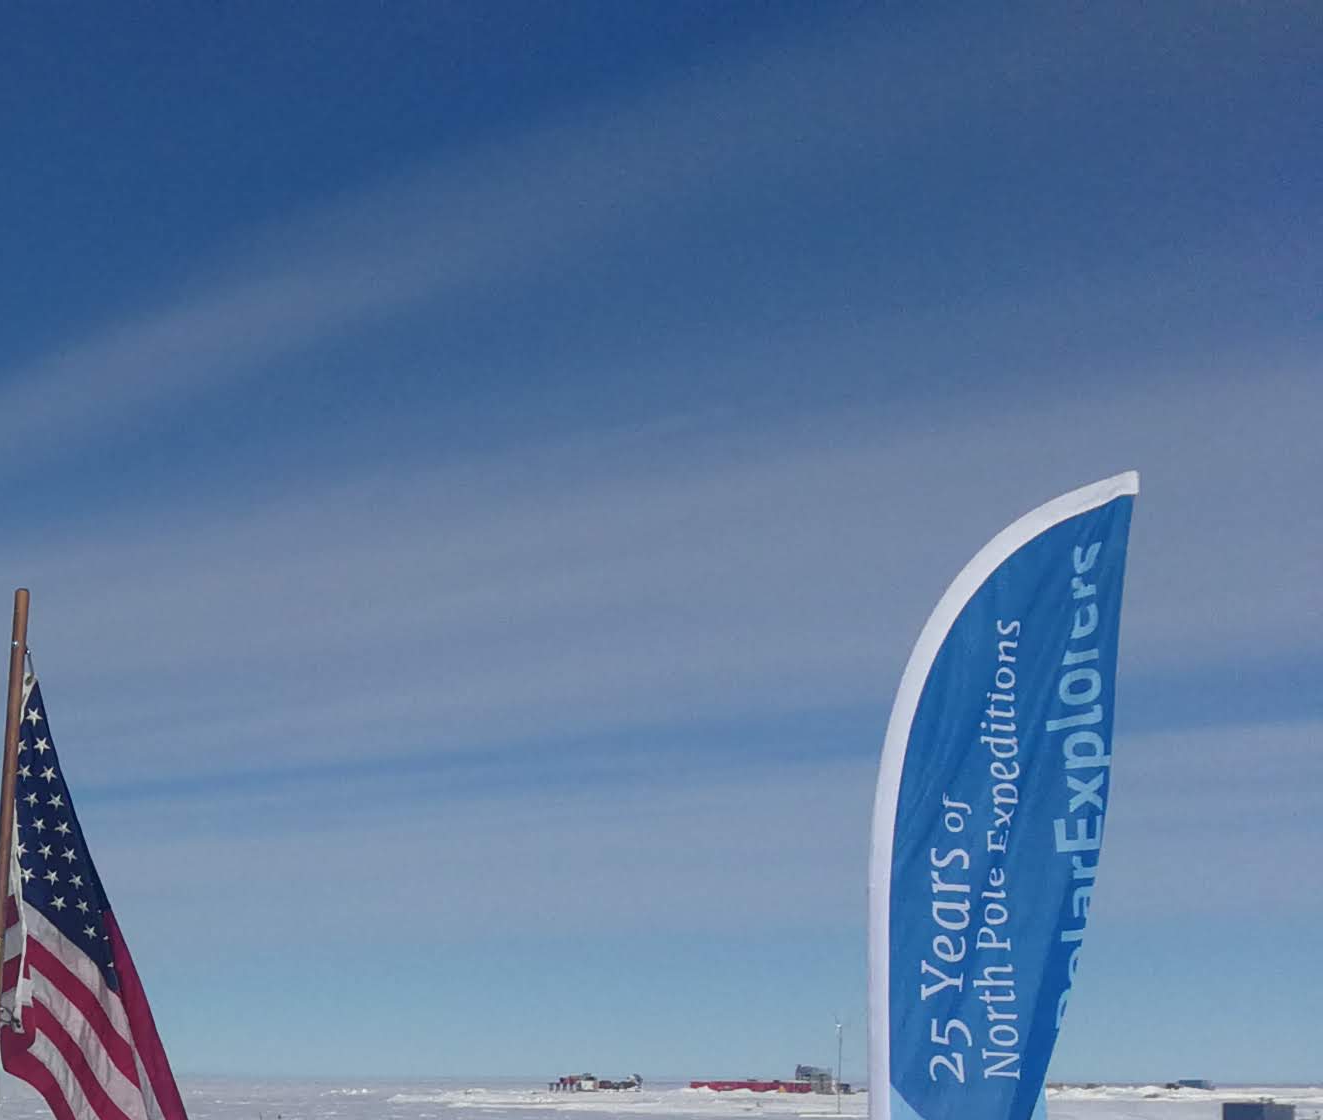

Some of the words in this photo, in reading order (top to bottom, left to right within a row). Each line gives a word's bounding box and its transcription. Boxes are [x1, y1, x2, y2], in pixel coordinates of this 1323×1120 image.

[980, 619, 1021, 854] Expeditions
[942, 792, 973, 833] of
[921, 848, 971, 1001] Years
[975, 866, 1012, 951] Pole
[929, 1018, 973, 1084] 25
[973, 963, 1021, 1080] North
